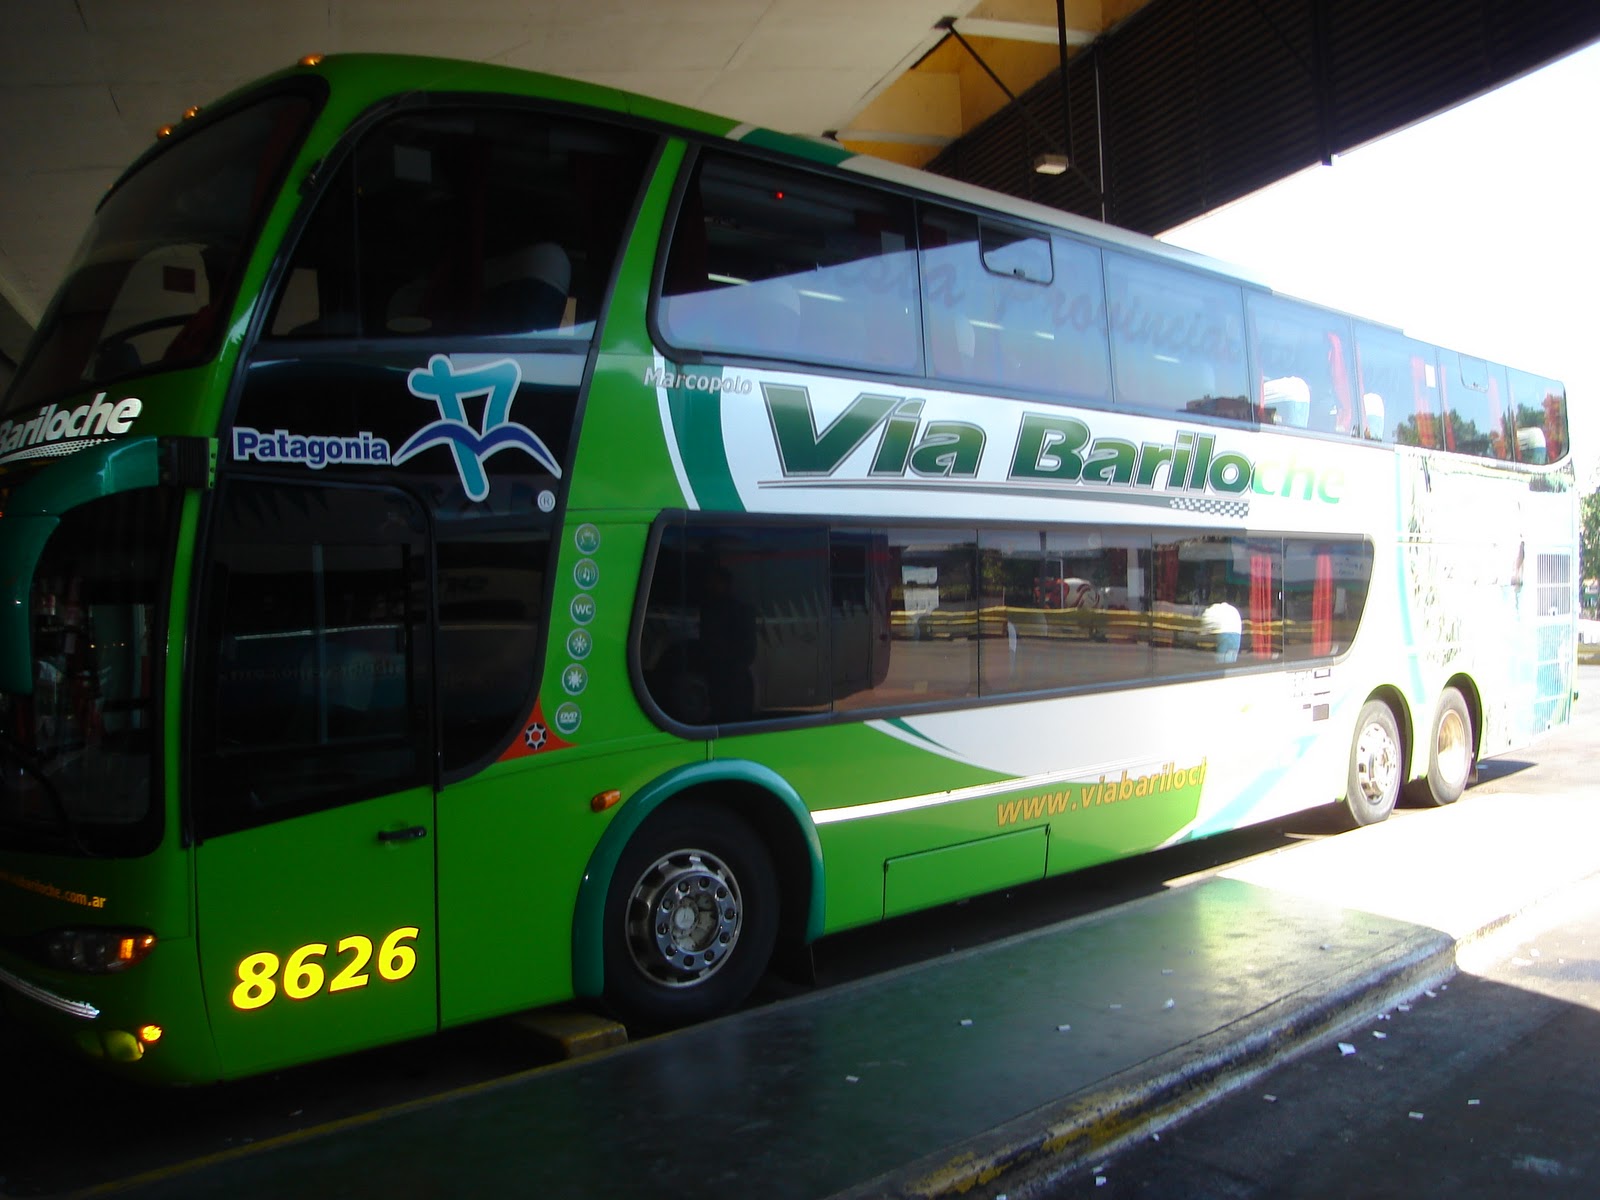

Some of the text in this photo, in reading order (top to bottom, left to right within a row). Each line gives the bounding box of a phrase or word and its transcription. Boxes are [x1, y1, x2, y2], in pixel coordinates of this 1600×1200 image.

[643, 366, 753, 395] Marcopolo
[233, 427, 391, 469] Patagonia
[759, 381, 1345, 504] Via Bariloche
[574, 603, 593, 616] WC
[231, 926, 421, 1011] 8626
